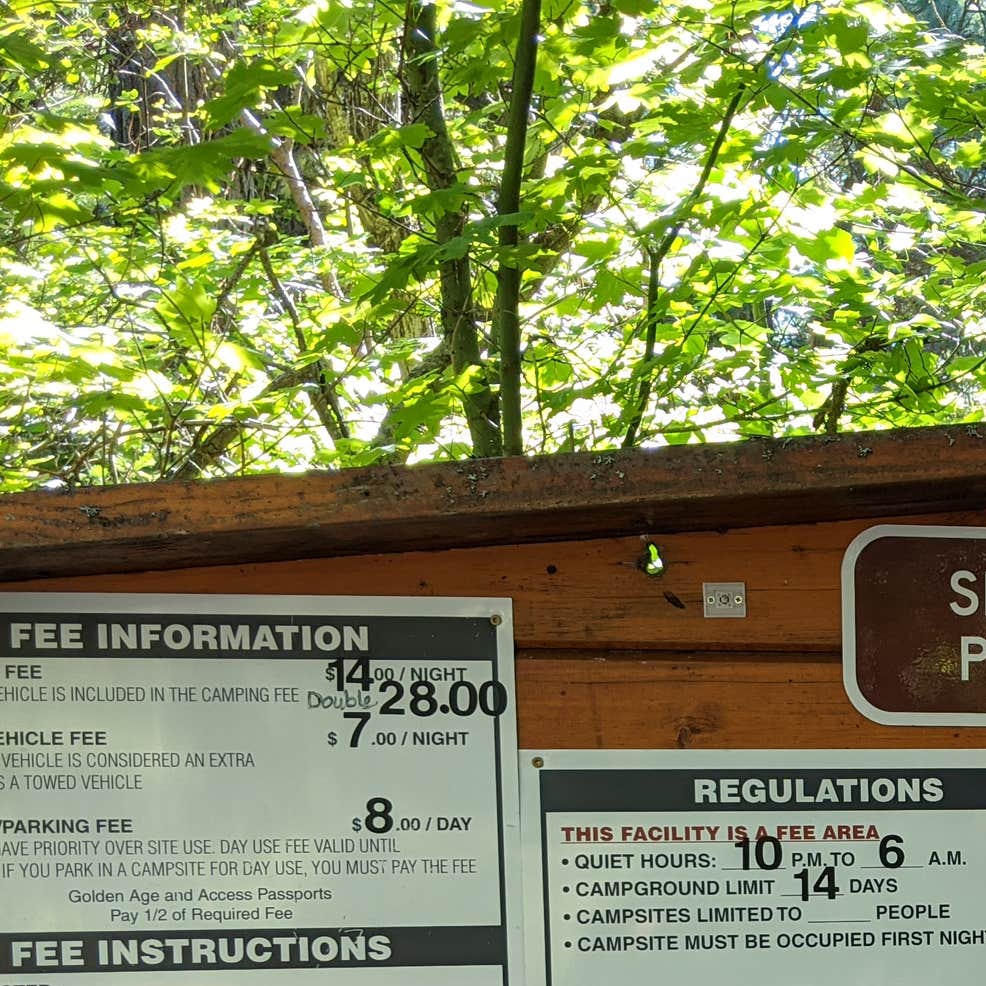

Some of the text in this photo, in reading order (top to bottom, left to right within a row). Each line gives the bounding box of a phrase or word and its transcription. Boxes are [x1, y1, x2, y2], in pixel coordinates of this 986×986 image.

[11, 623, 368, 651] FEE INFORMATION
[5, 665, 42, 679] FEE
[411, 667, 467, 681] NIGHT
[307, 689, 378, 710] Double
[379, 680, 508, 717] 28.00
[70, 732, 107, 745] FEE
[412, 732, 470, 745] NIGHT
[1, 752, 255, 768] VEHICLE IS CONSIDERED AN EXTRA
[693, 778, 945, 803] REGULATIONS
[96, 819, 133, 833] FEE
[437, 817, 472, 831] DAY
[561, 825, 880, 842] THIS FACILITY IS A FEE AREA
[575, 834, 967, 871] QUIET HOURS: 10 P.M. TO 6 A.M.
[576, 867, 898, 901] CAMPGROUND LIMIT 14 DAYS
[69, 888, 332, 905] Golden Age and Access Passports
[111, 907, 293, 925] Pay 1/2 of Required Fee
[12, 932, 391, 966] FEE INSTRUCTIONS
